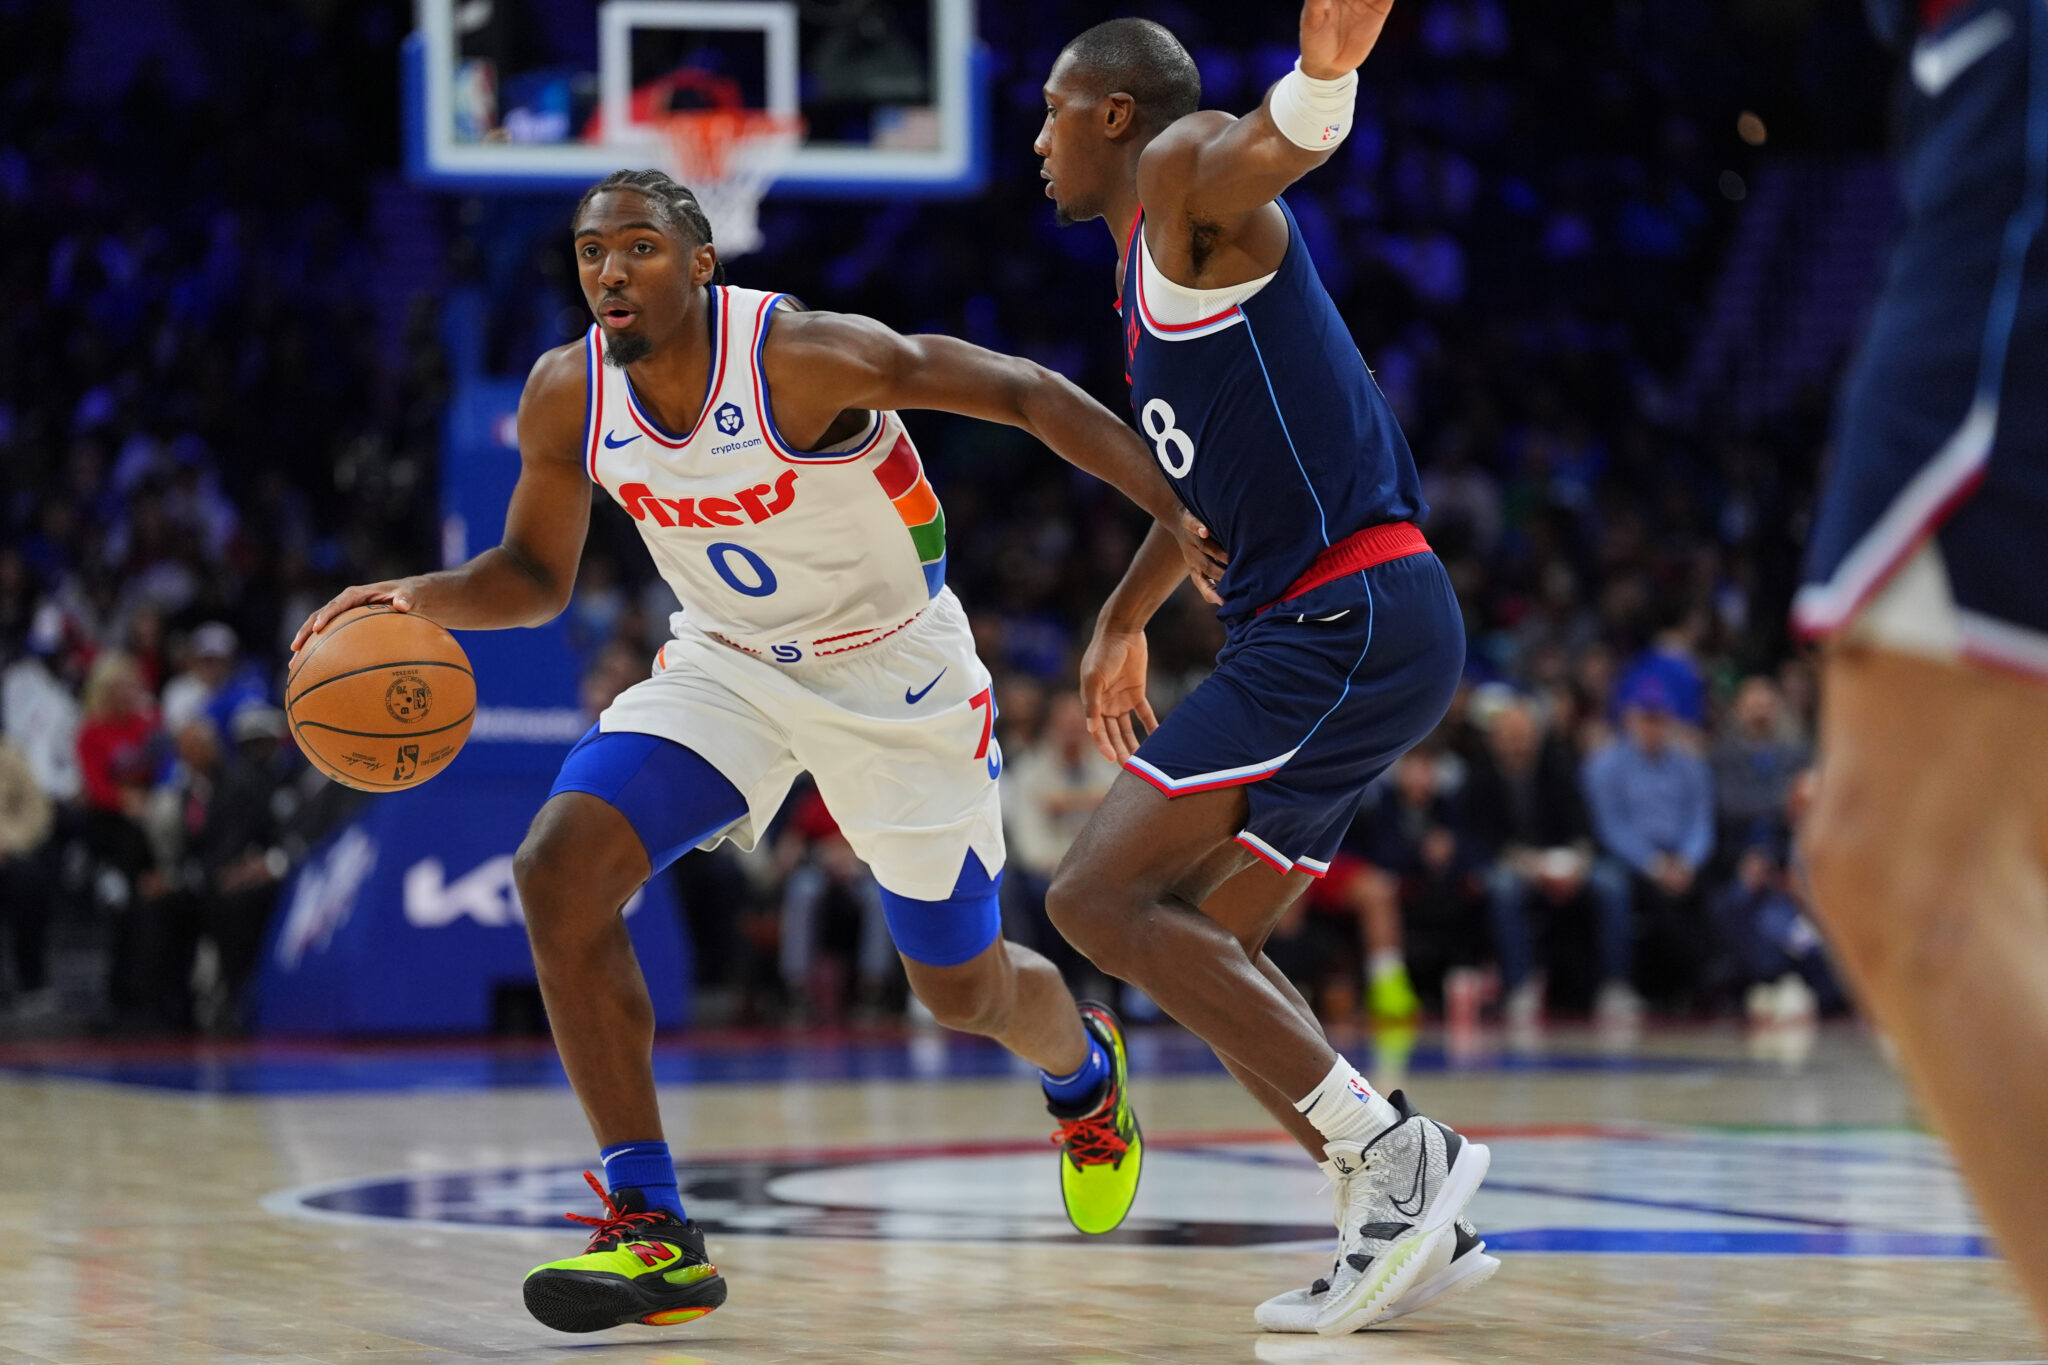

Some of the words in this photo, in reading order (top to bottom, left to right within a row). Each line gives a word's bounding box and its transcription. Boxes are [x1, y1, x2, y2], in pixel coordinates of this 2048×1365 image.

[711, 438, 762, 455] crypto.com
[1141, 398, 1195, 479] 8
[618, 468, 799, 528] Sixers
[706, 542, 777, 598] 0
[626, 1241, 675, 1267] N
